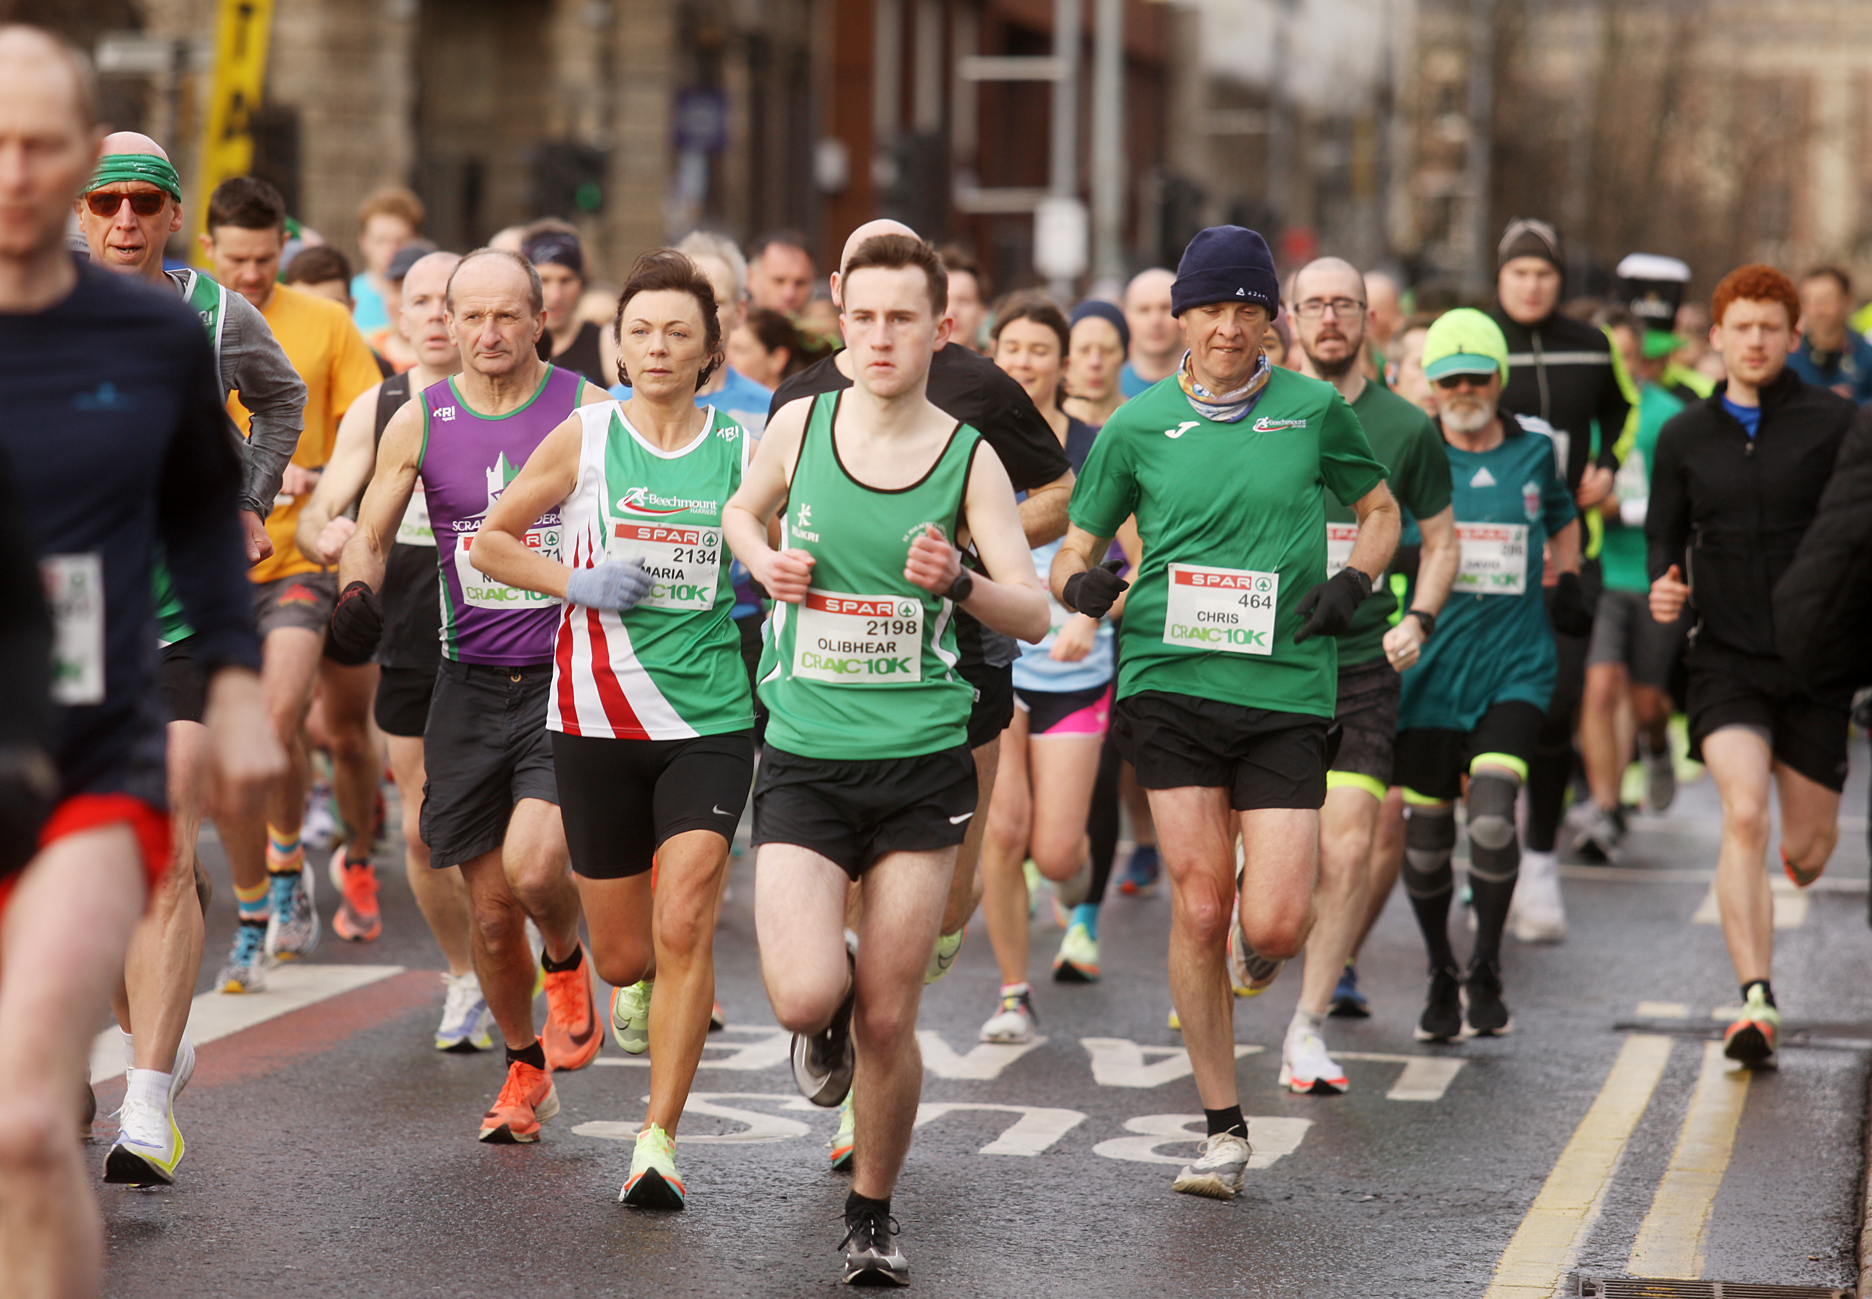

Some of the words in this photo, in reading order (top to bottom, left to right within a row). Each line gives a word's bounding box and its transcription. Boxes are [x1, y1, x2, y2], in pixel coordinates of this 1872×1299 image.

[648, 493, 718, 510] Beechmount
[690, 507, 717, 516] HARRIERS
[452, 519, 483, 532] SCRA
[791, 524, 819, 543] KUKRI
[637, 527, 698, 544] SPAR
[672, 547, 717, 565] 2134
[1465, 560, 1500, 569] DAVID
[640, 566, 685, 580] MARIA
[1191, 573, 1251, 589] SPAR
[825, 599, 893, 616] SPAR
[1238, 593, 1272, 610] 464
[1197, 610, 1239, 624] CHRIS
[866, 620, 917, 636] 2198
[817, 637, 897, 654] OLIBHEAR
